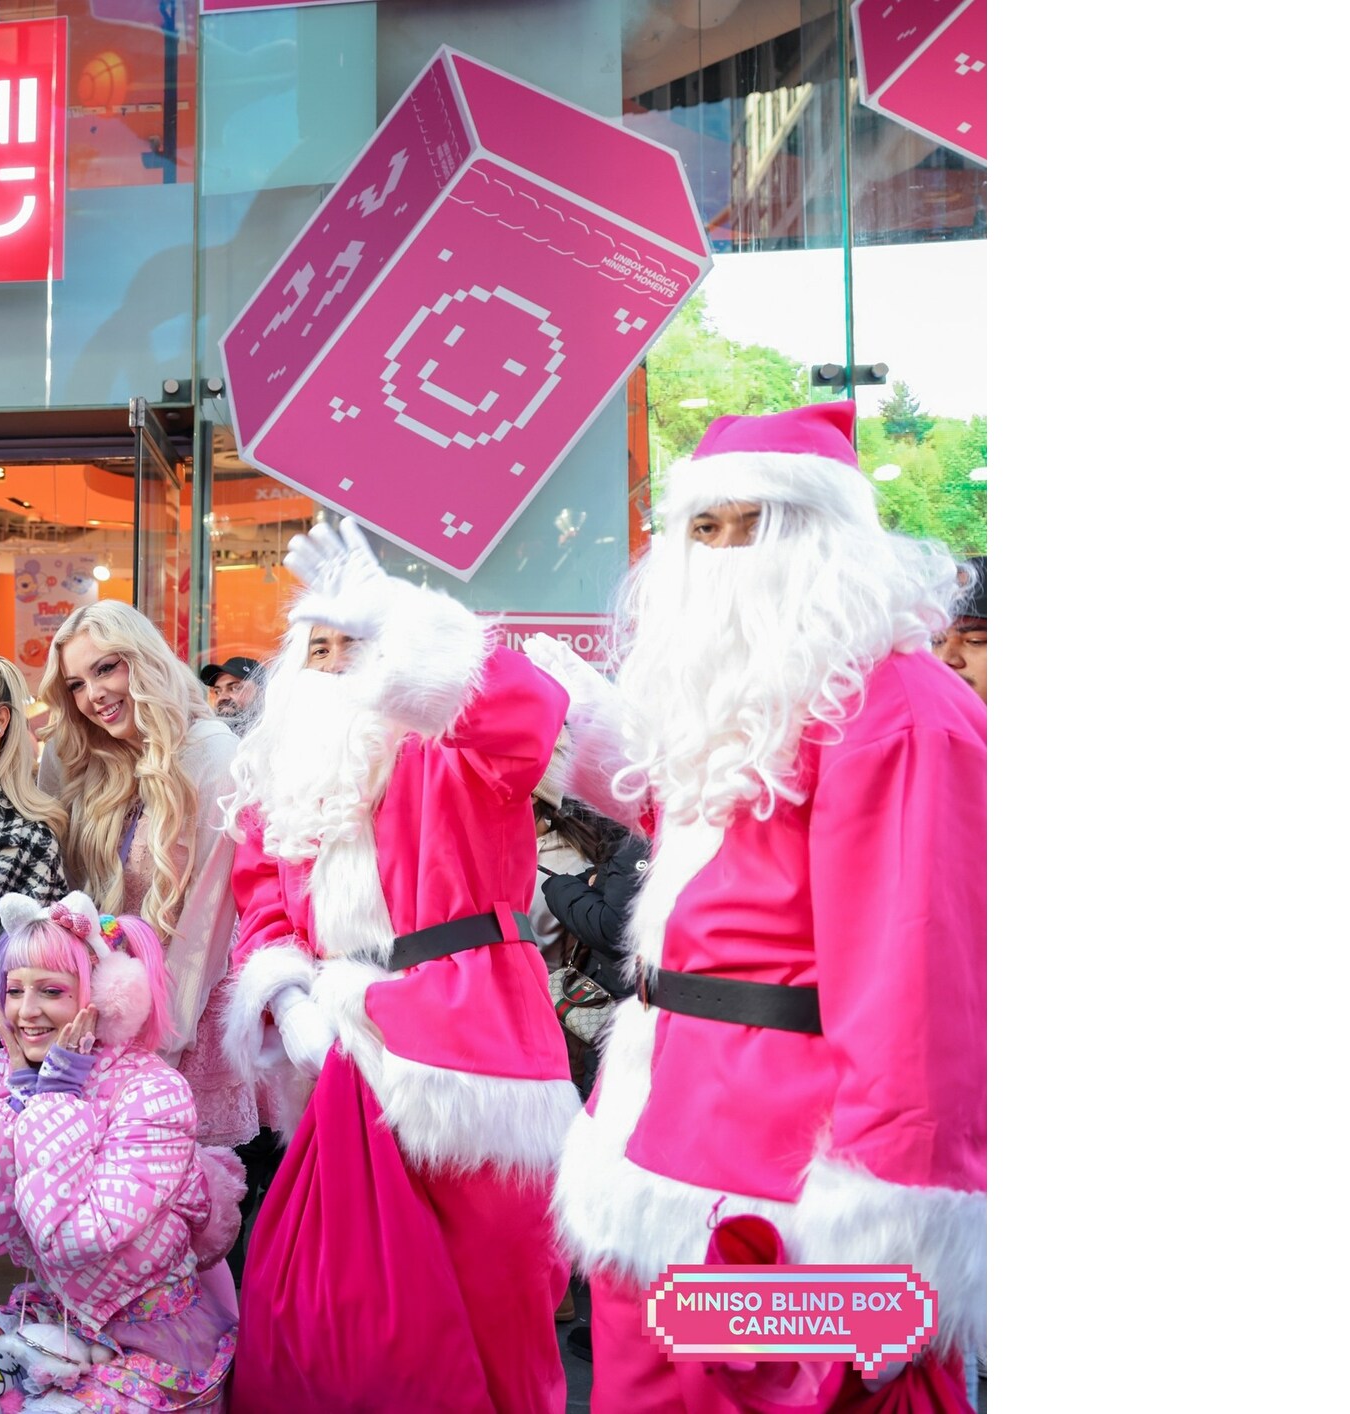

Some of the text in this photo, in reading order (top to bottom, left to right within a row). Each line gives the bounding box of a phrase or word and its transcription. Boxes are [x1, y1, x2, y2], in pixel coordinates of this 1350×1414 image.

[601, 256, 676, 298] MINISO MOMENTS
[613, 252, 680, 291] UNBOX MAGICAL
[35, 1118, 89, 1169] HELLO
